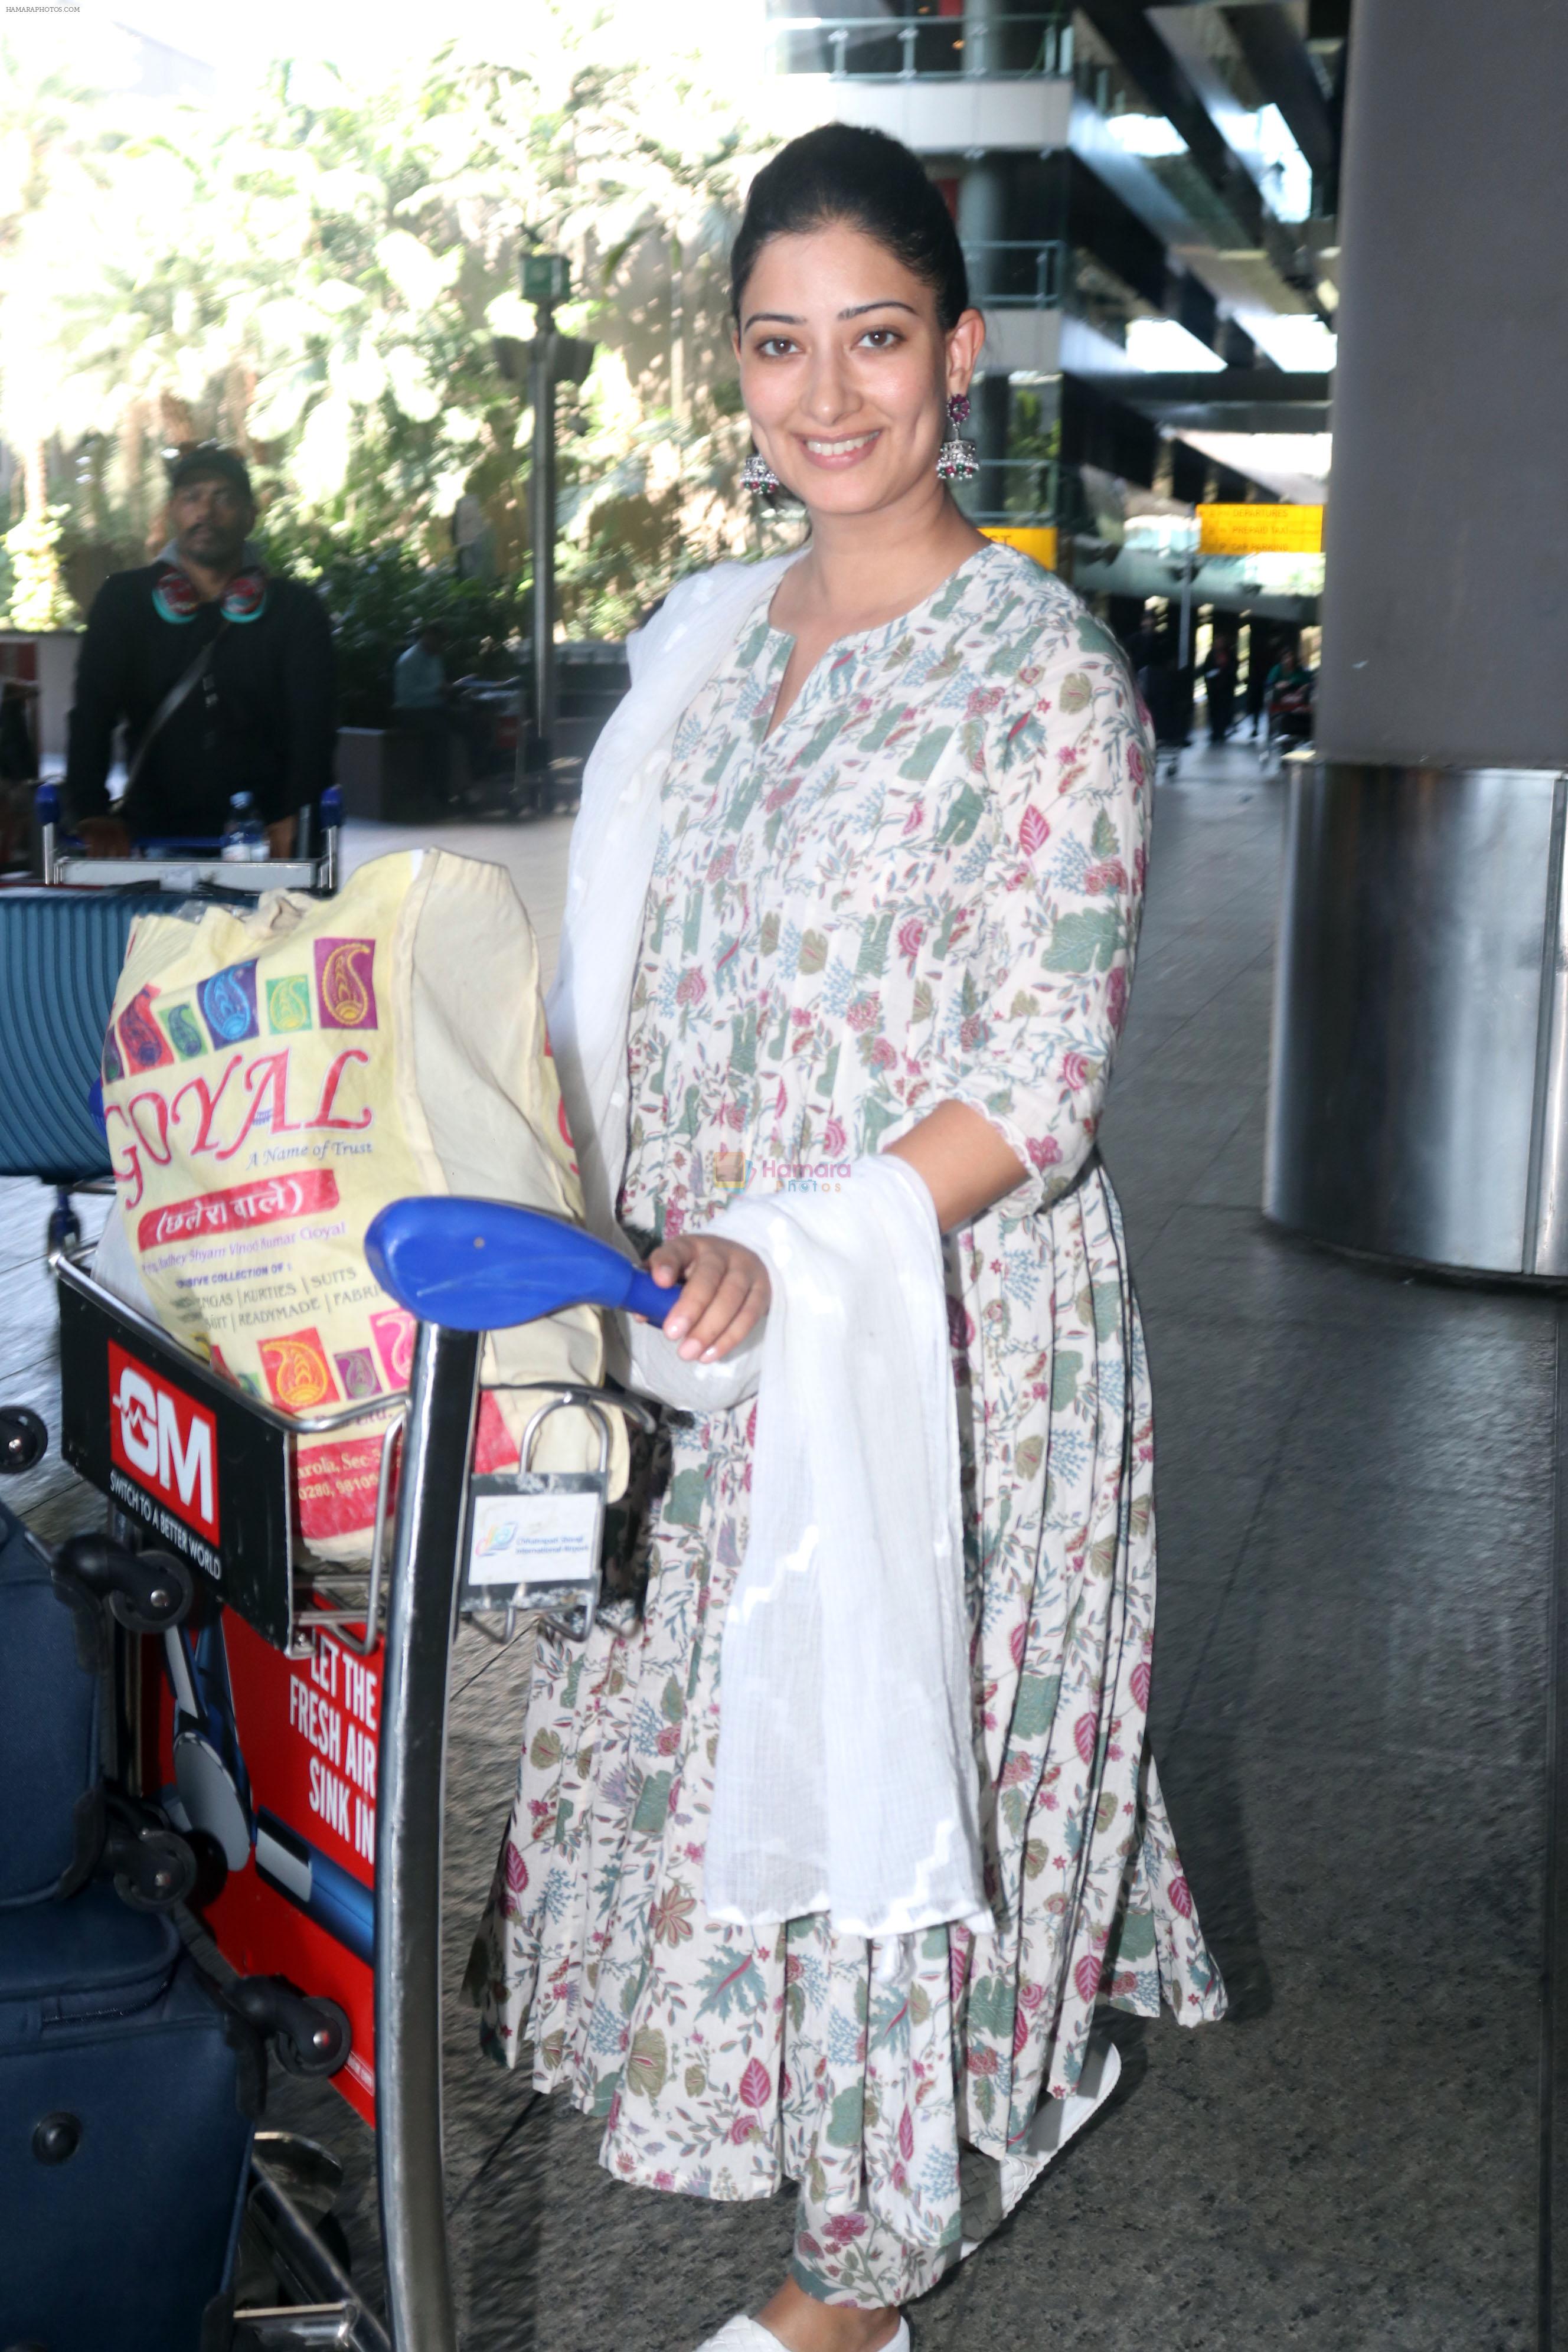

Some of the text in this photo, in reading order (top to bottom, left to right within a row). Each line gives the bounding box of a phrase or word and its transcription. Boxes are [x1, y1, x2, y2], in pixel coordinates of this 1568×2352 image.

[1233, 509, 1289, 517] DEPARTURES
[1233, 526, 1268, 534] PREPAID
[1271, 525, 1289, 534] TAXI
[1231, 543, 1249, 552] CAR
[1251, 543, 1289, 552] PARKING
[246, 1140, 373, 1171] A Name of Trust
[260, 1231, 295, 1251] Kumar
[299, 1221, 346, 1242] Goyal
[211, 1266, 269, 1285] COLLECTION
[243, 1282, 297, 1304] KURTIES
[310, 1266, 357, 1288] SUITS
[238, 1297, 320, 1327] READYMADE
[112, 1366, 214, 1525] GM
[110, 1469, 222, 1580] SWITCH TO A BETTER WORLD
[311, 1628, 377, 1732] LET THE
[290, 1674, 377, 1799] FRESH AIR
[308, 1756, 375, 1866] SINK IN
